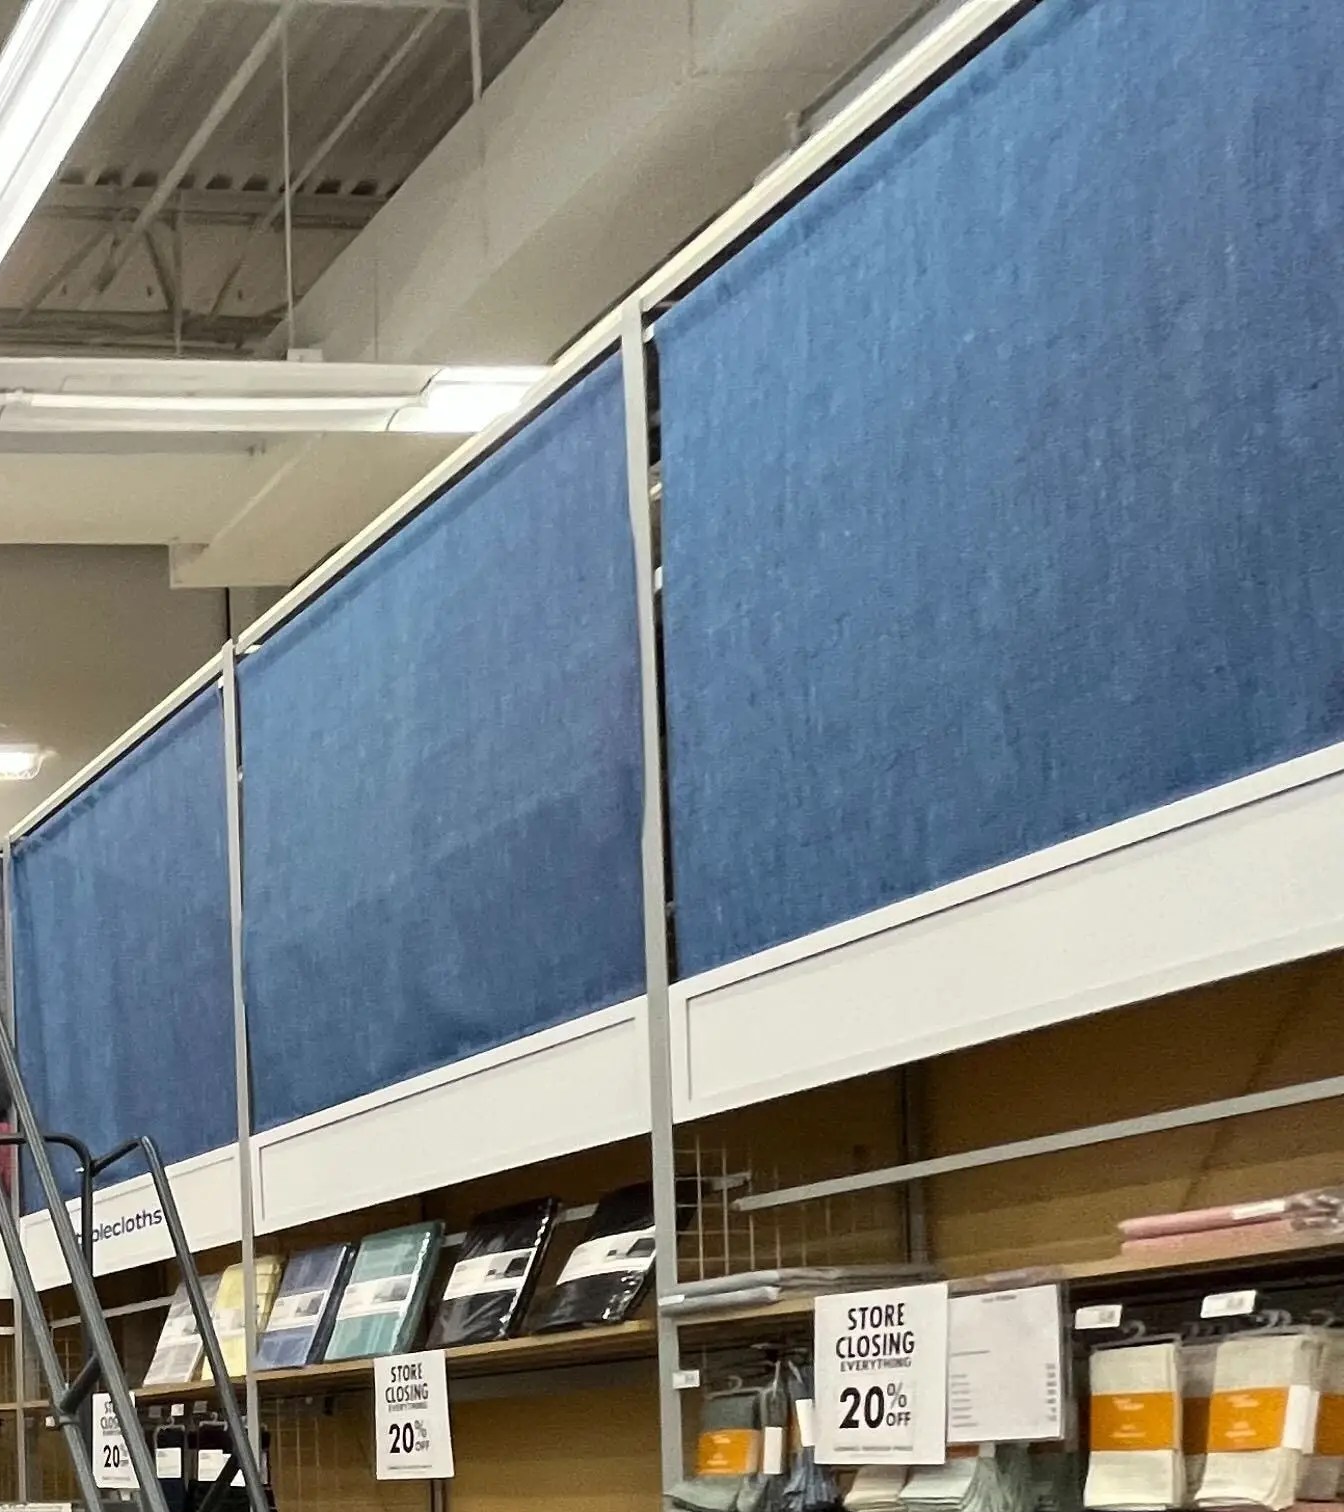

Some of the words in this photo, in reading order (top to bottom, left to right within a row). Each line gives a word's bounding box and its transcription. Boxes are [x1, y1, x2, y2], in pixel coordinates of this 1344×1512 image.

[847, 1302, 905, 1331] STORE
[835, 1331, 915, 1359] CLOSING
[391, 1362, 422, 1383] STORE
[840, 1356, 912, 1372] EVERYTHING
[385, 1382, 429, 1403] CLOSING
[886, 1411, 911, 1427] OFF
